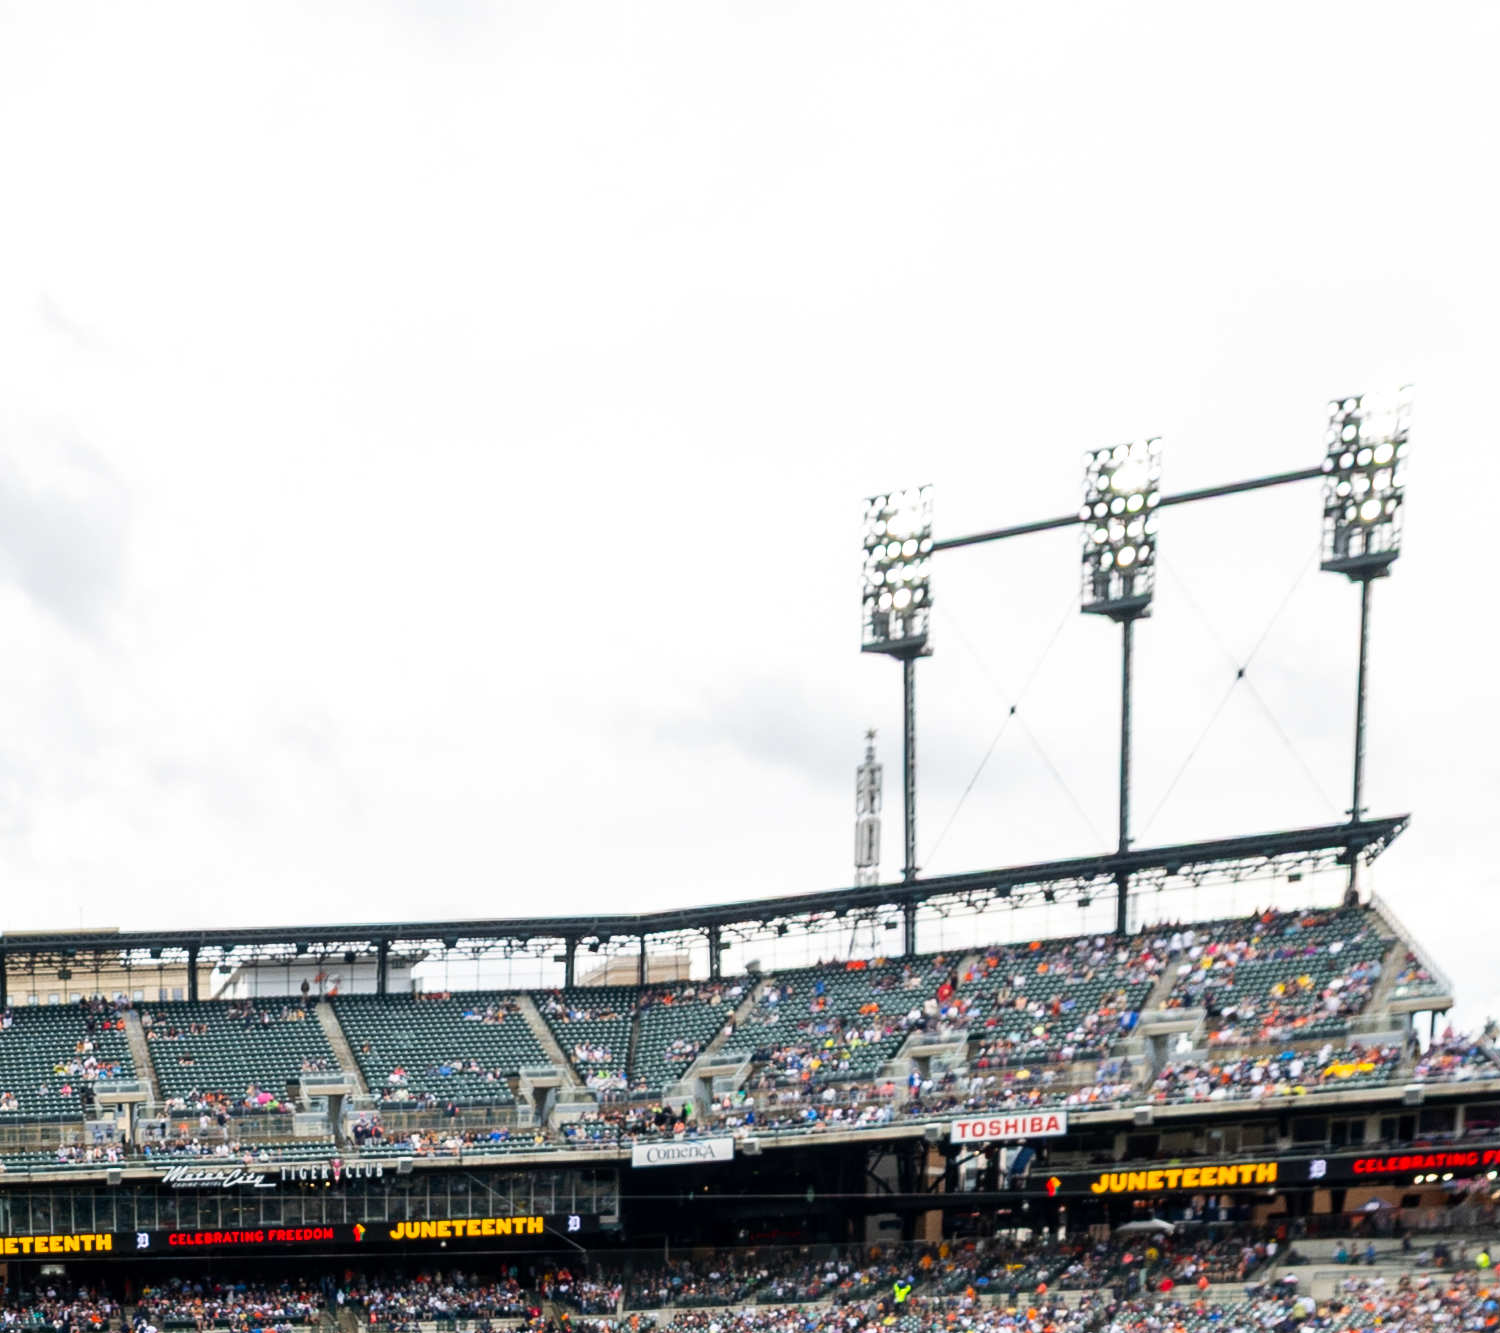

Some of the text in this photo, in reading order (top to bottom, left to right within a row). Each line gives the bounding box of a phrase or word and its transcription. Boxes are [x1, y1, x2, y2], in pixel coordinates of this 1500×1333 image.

[957, 1115, 1060, 1138] TOSHIBA
[281, 1163, 384, 1181] TIGER CLUB
[1352, 1151, 1478, 1174] CELEBRATING
[1091, 1162, 1278, 1194] JUNETEENTH
[168, 1227, 334, 1246] CELEBRATING FREEDOM
[389, 1216, 544, 1240] JUNETEENTH
